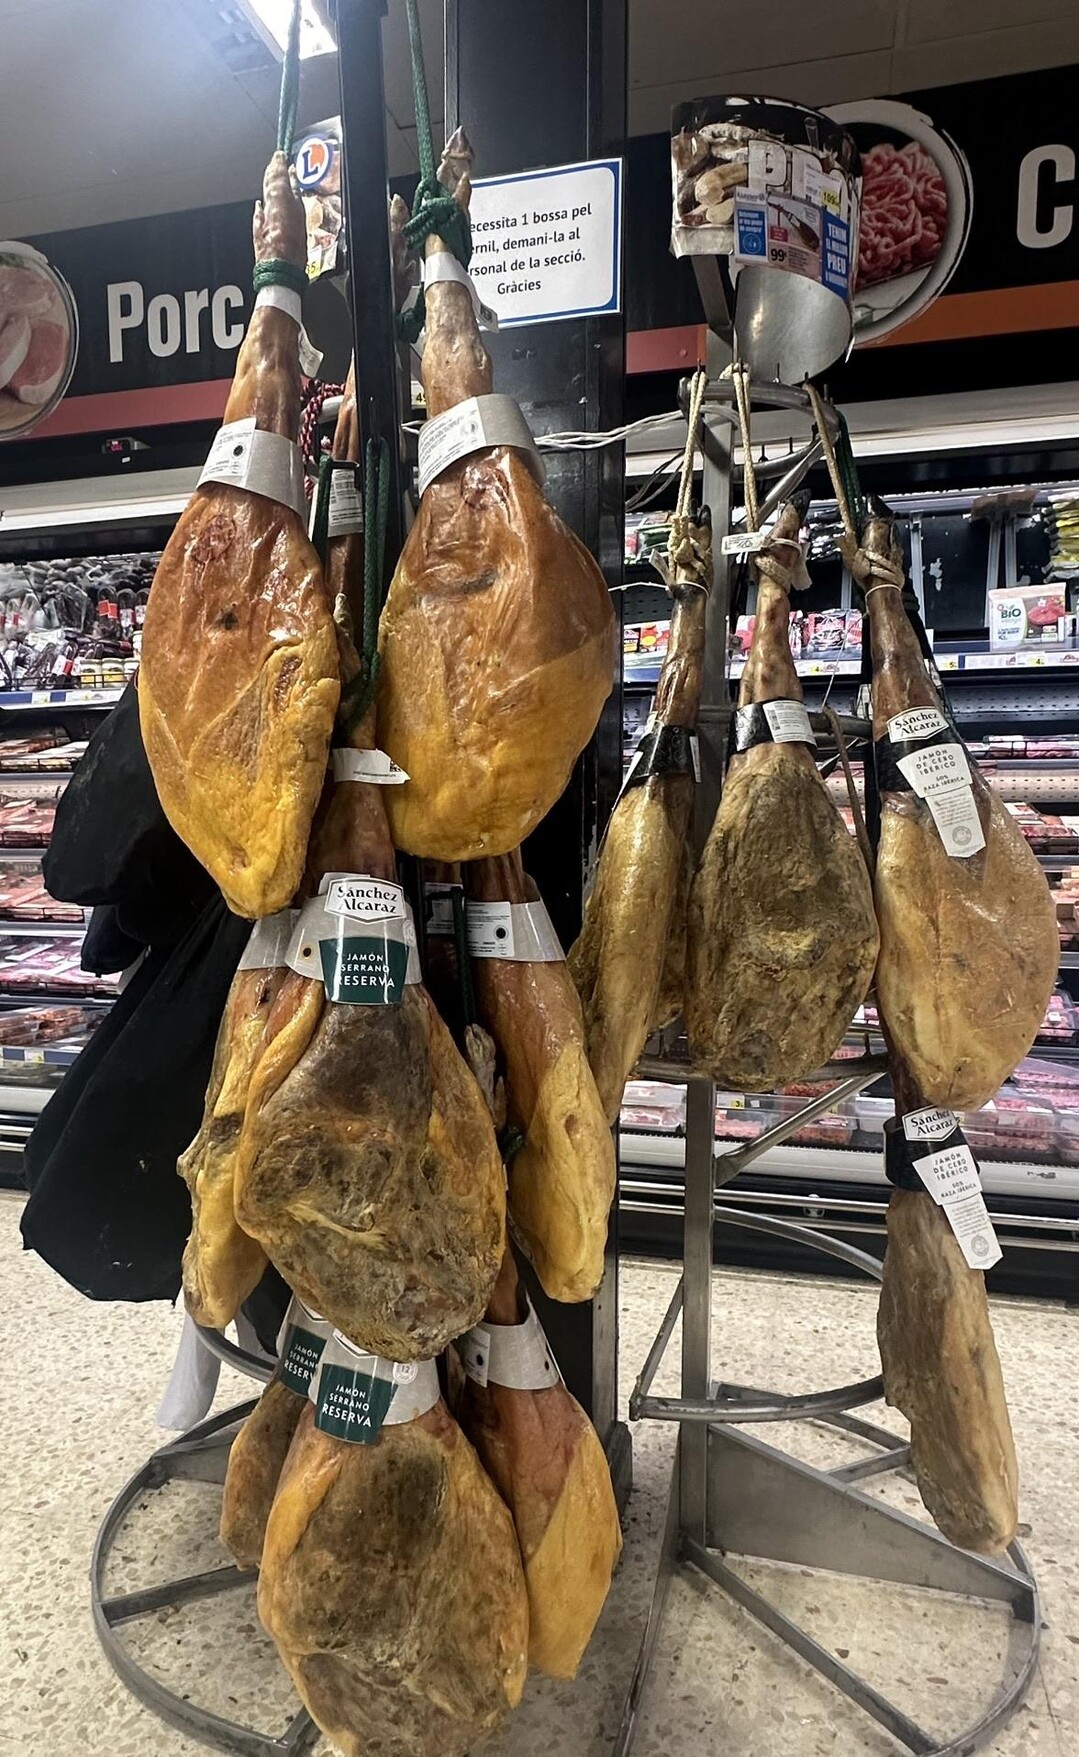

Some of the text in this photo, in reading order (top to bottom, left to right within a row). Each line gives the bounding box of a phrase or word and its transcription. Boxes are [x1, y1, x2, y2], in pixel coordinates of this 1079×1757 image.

[470, 203, 592, 232] ecessita 1 bossa pel
[472, 228, 580, 254] rnil, demani-la al
[469, 249, 586, 276] rsonal de la secció.
[497, 279, 541, 295] Gràcies
[107, 281, 245, 363] Porc
[1001, 608, 1021, 619] BIO
[895, 713, 939, 729] Sánchez
[901, 721, 941, 736] Alcaraz
[932, 754, 954, 764] CEBO
[338, 887, 398, 902] Sánchez
[339, 899, 397, 914] Alcaraz
[347, 952, 384, 961] JAMÓN
[341, 964, 390, 973] SERRANO
[948, 1158, 966, 1169] CEBO
[295, 1344, 319, 1359] JAMÓN
[336, 1384, 366, 1399] JAMÓN
[329, 1393, 370, 1412] SERRANO
[322, 1404, 372, 1428] RESERVA
